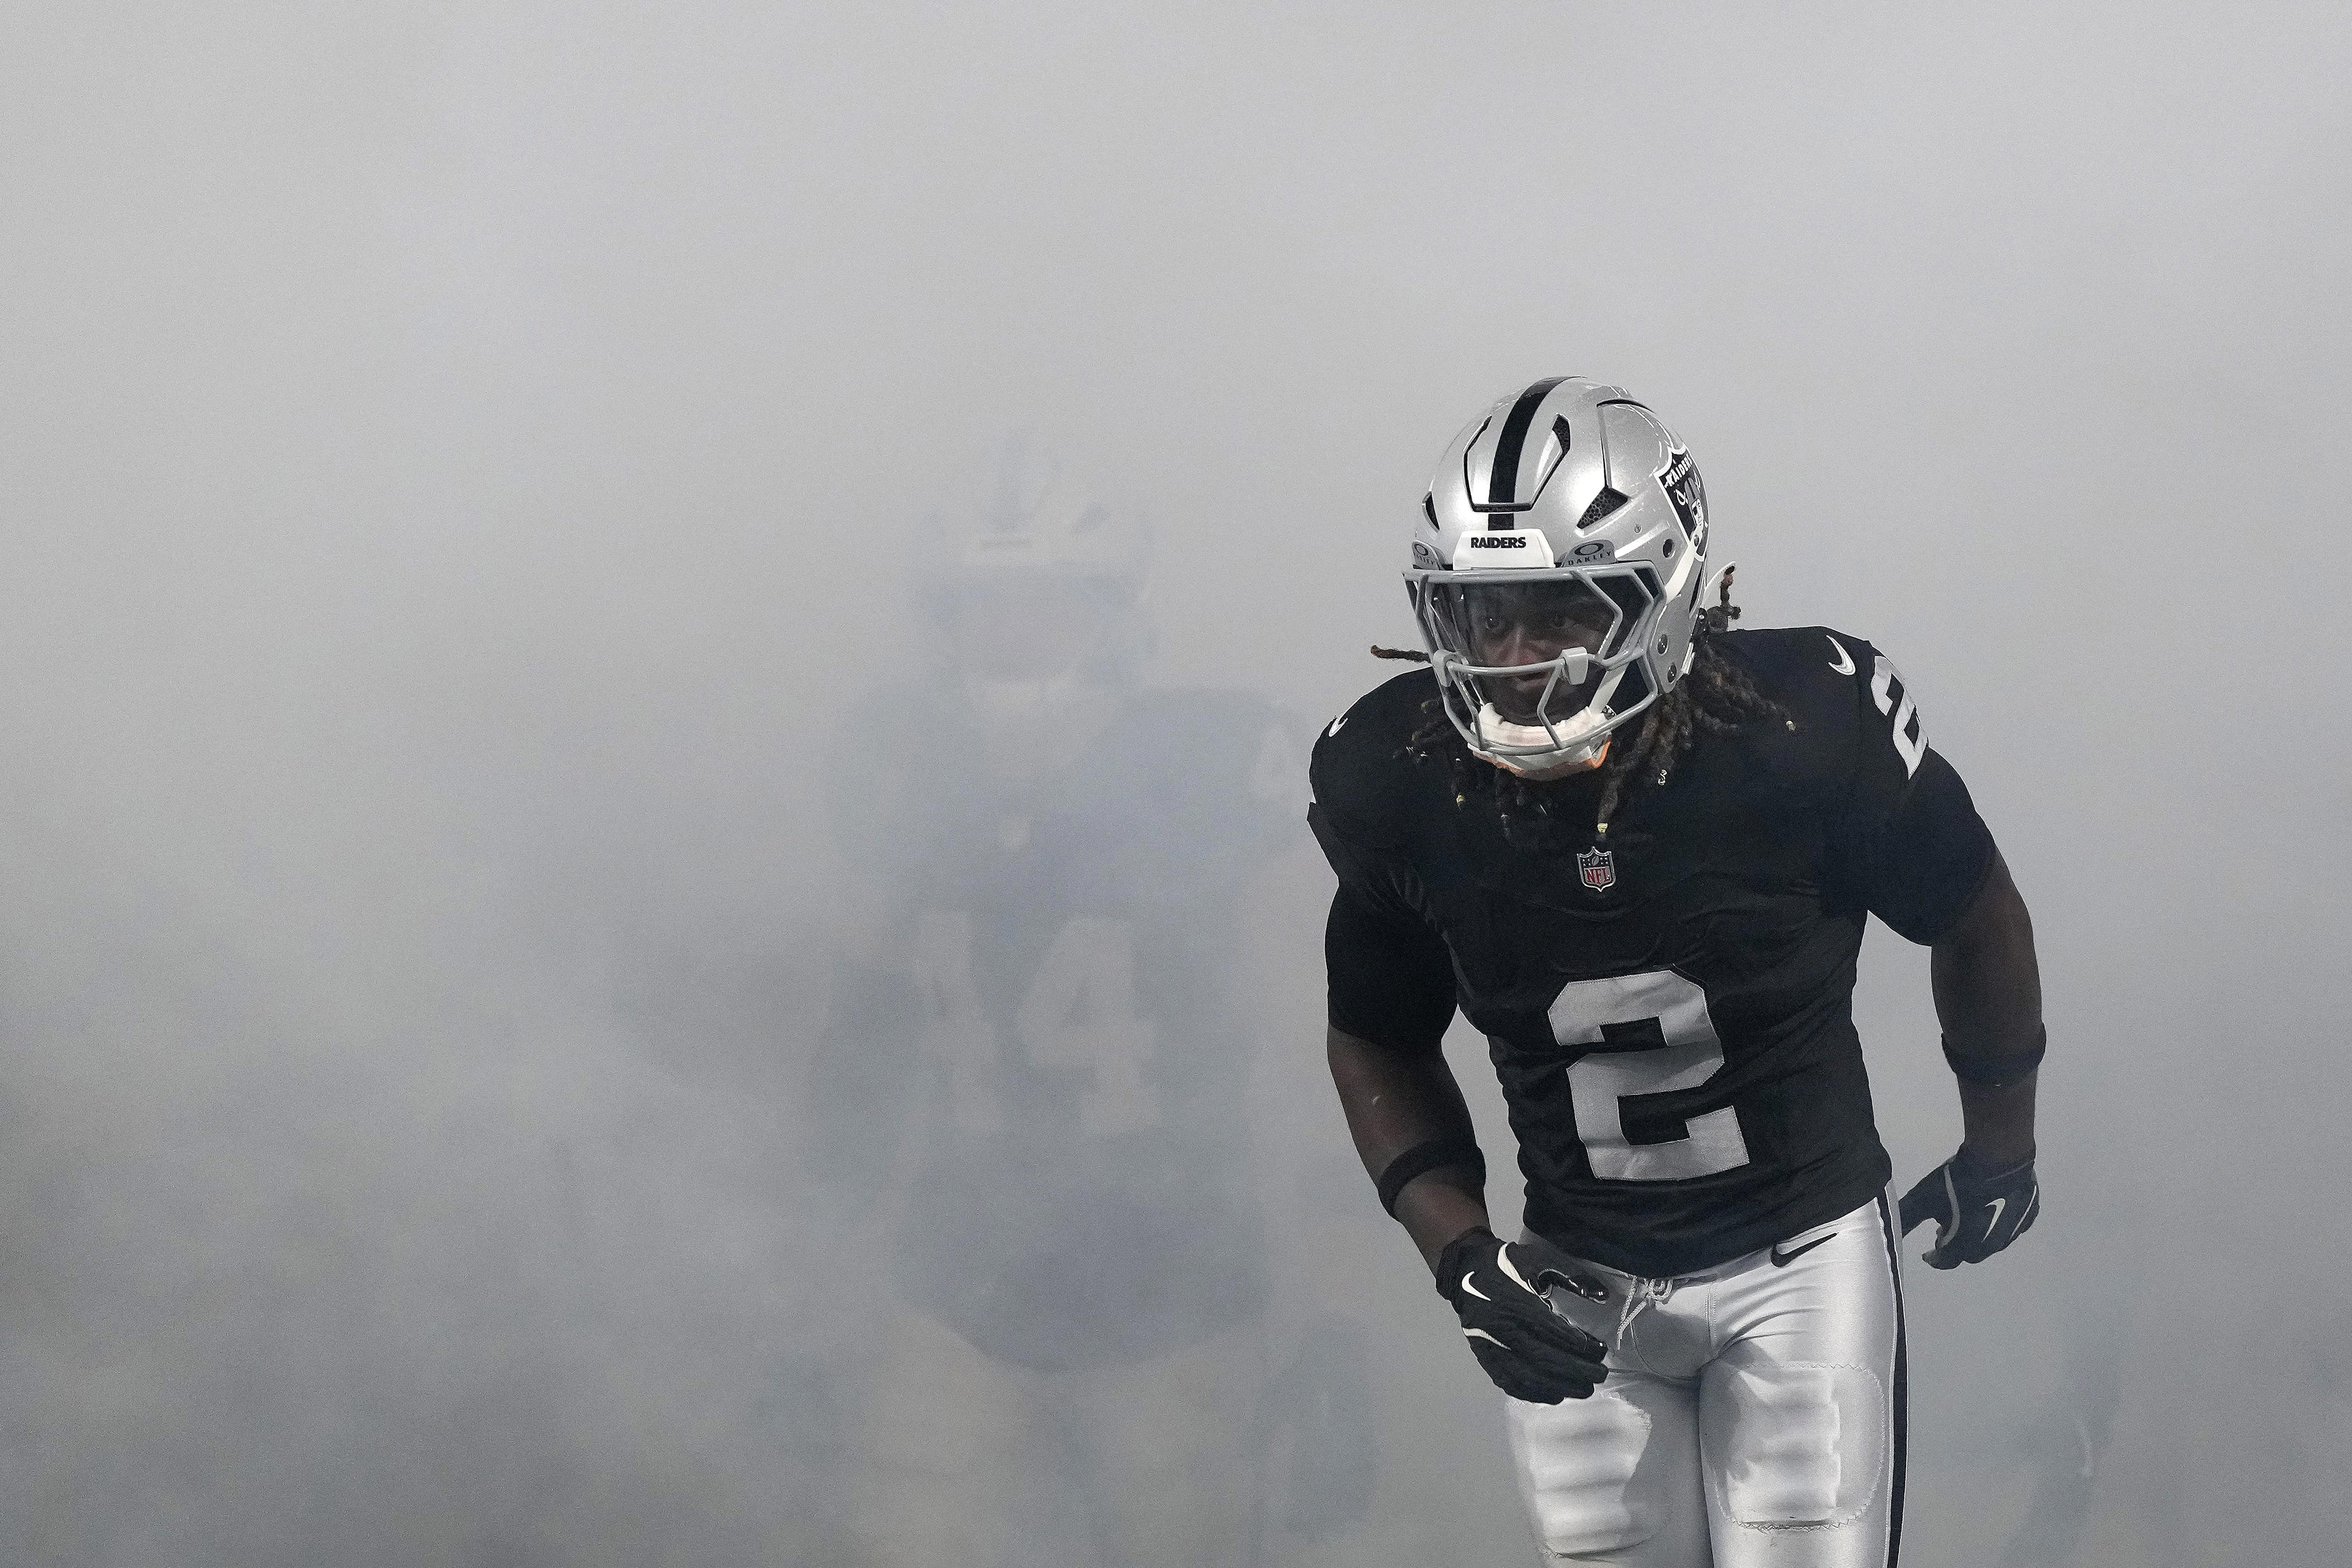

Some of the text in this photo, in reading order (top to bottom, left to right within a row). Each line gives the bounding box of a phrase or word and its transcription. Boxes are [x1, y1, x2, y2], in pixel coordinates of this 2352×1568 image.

[1471, 537, 1527, 549] RAIDERS
[1871, 655, 1929, 781] 2
[1585, 867, 1610, 884] NFL
[1548, 970, 1750, 1180] 2
